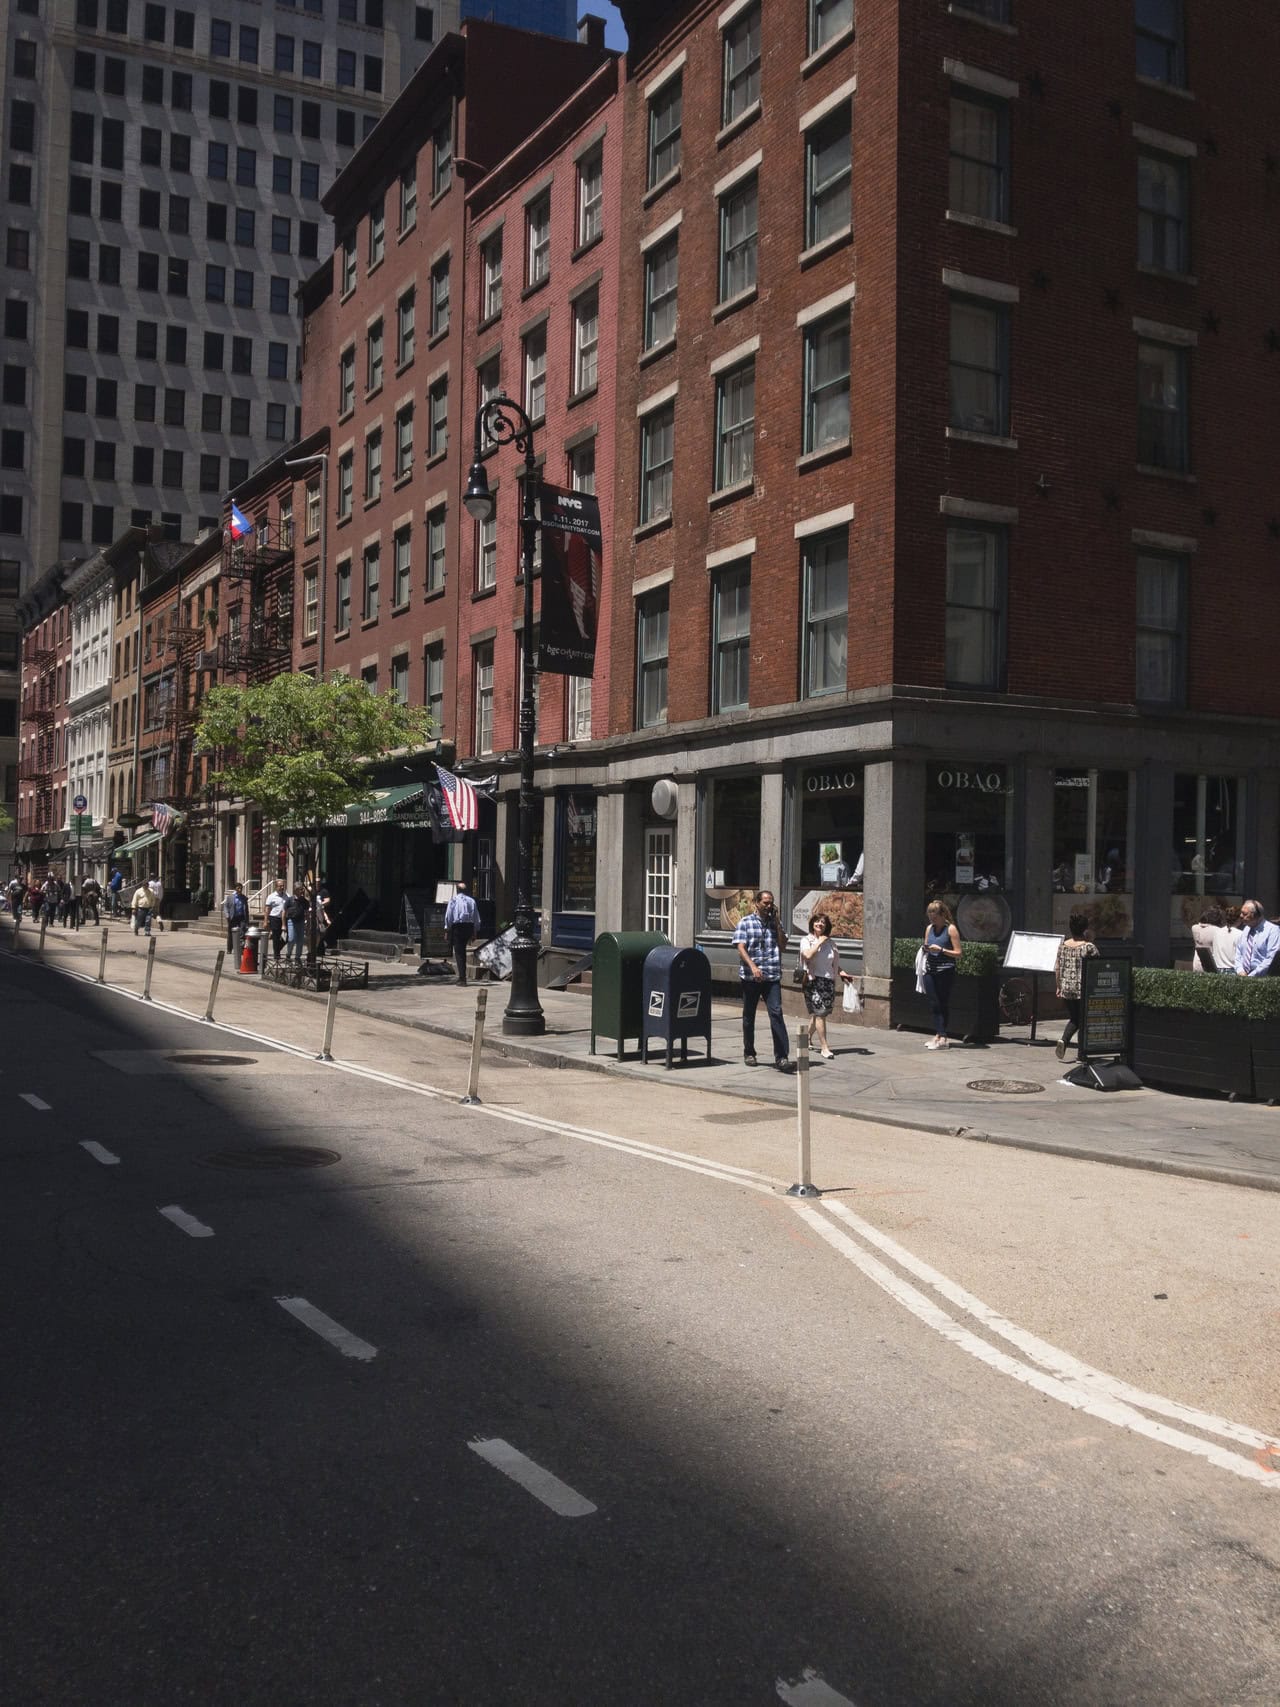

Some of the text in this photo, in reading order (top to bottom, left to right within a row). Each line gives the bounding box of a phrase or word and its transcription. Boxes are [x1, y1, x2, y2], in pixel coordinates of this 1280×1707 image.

[557, 495, 583, 510] NYC
[807, 772, 856, 792] OBAO
[938, 770, 1001, 789] OBAO
